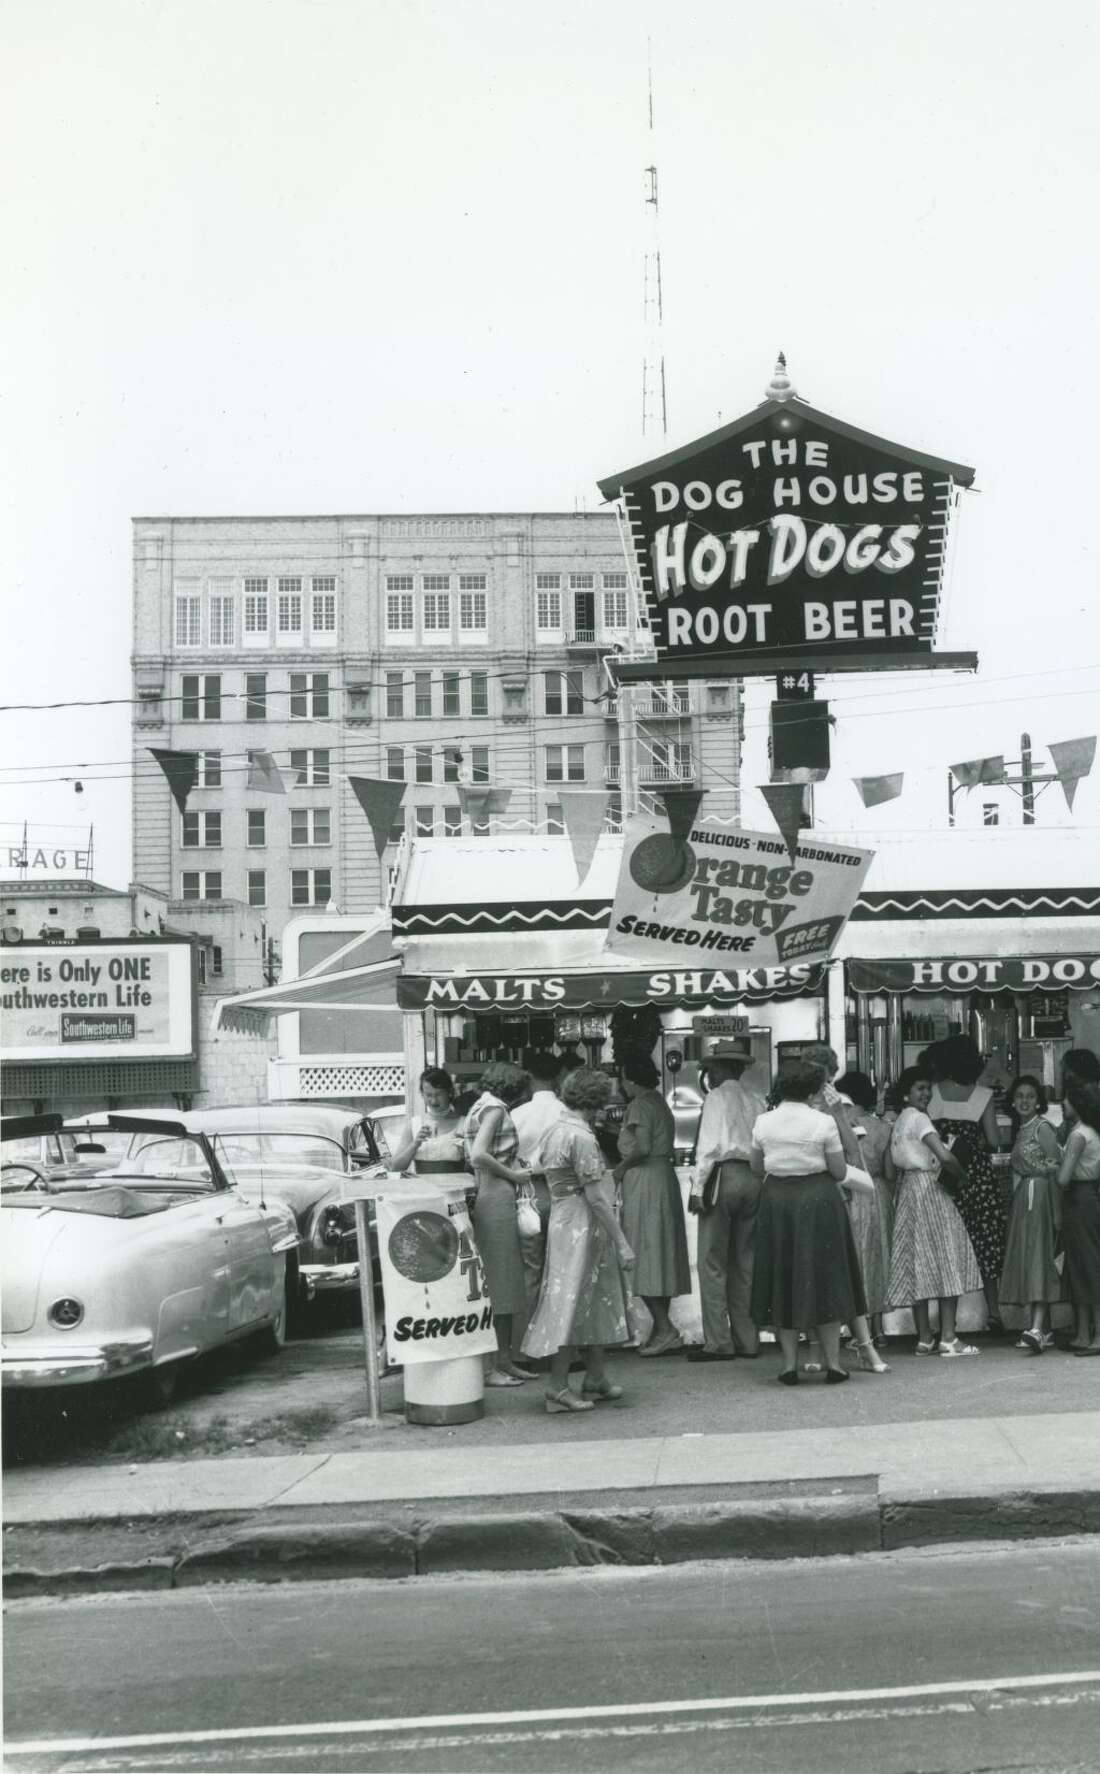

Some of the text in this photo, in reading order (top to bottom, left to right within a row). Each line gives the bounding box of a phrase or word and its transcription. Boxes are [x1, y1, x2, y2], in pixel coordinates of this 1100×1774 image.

[742, 438, 829, 469] THE
[651, 472, 925, 512] DOG HOUSE
[651, 513, 922, 601] HOT DOGS
[667, 600, 916, 646] ROOT BEER
[782, 675, 810, 692] #4
[690, 830, 862, 866] DELICIOUS NON-ARBONATED
[690, 883, 796, 936] Tasty
[617, 915, 701, 947] SERVED
[702, 929, 757, 952] HERE
[783, 924, 830, 949] FREE
[37, 961, 52, 982] is
[59, 958, 101, 986] Only
[108, 957, 152, 981] ONE
[425, 963, 811, 1001] MALTS SHAKES
[911, 960, 1003, 984] HOT
[0, 983, 152, 1009] uthwestern Life
[63, 1018, 117, 1037] Southwestern
[118, 1018, 132, 1034] Life
[393, 1313, 480, 1342] SERVED
